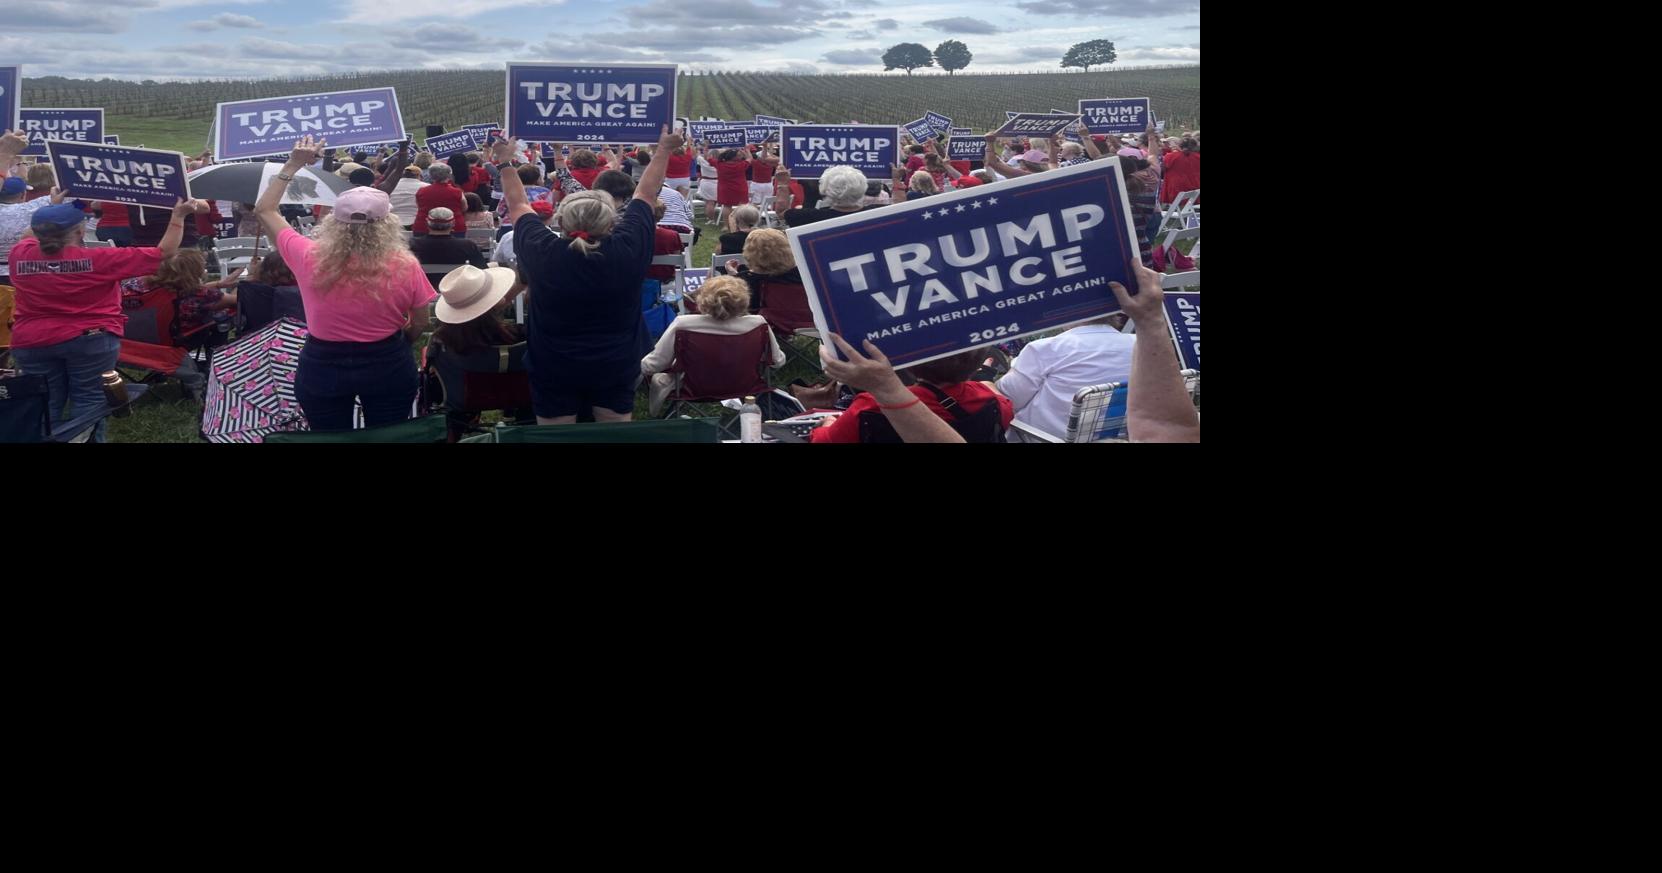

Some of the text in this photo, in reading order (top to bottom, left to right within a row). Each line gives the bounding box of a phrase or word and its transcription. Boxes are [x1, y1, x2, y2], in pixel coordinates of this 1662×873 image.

[519, 81, 665, 102] TRUMP
[231, 100, 385, 127] TRUMP
[535, 102, 648, 119] VANCE
[1084, 106, 1144, 117] TRUMP
[248, 114, 373, 137] VANCE
[927, 114, 949, 124] TRUMP
[1014, 118, 1071, 126] TRUMP
[1091, 115, 1139, 124] VANCE
[909, 122, 929, 134] TRUMP
[915, 128, 931, 137] VANCE
[430, 134, 469, 148] TRUMP
[706, 132, 743, 140] TRUMP
[789, 136, 891, 151] TRUMP
[437, 140, 468, 152] VANCE
[800, 150, 880, 162] VANCE
[59, 154, 176, 177] TRUMP
[75, 169, 167, 190] VANCE
[828, 203, 1105, 293] TRUMP
[870, 245, 1088, 318] VANCE
[866, 322, 913, 341] MAKE
[917, 303, 990, 329] AMERICA
[995, 290, 1046, 310] GREAT
[1051, 276, 1106, 297] AGAIN!
[969, 322, 1020, 343] 2024
